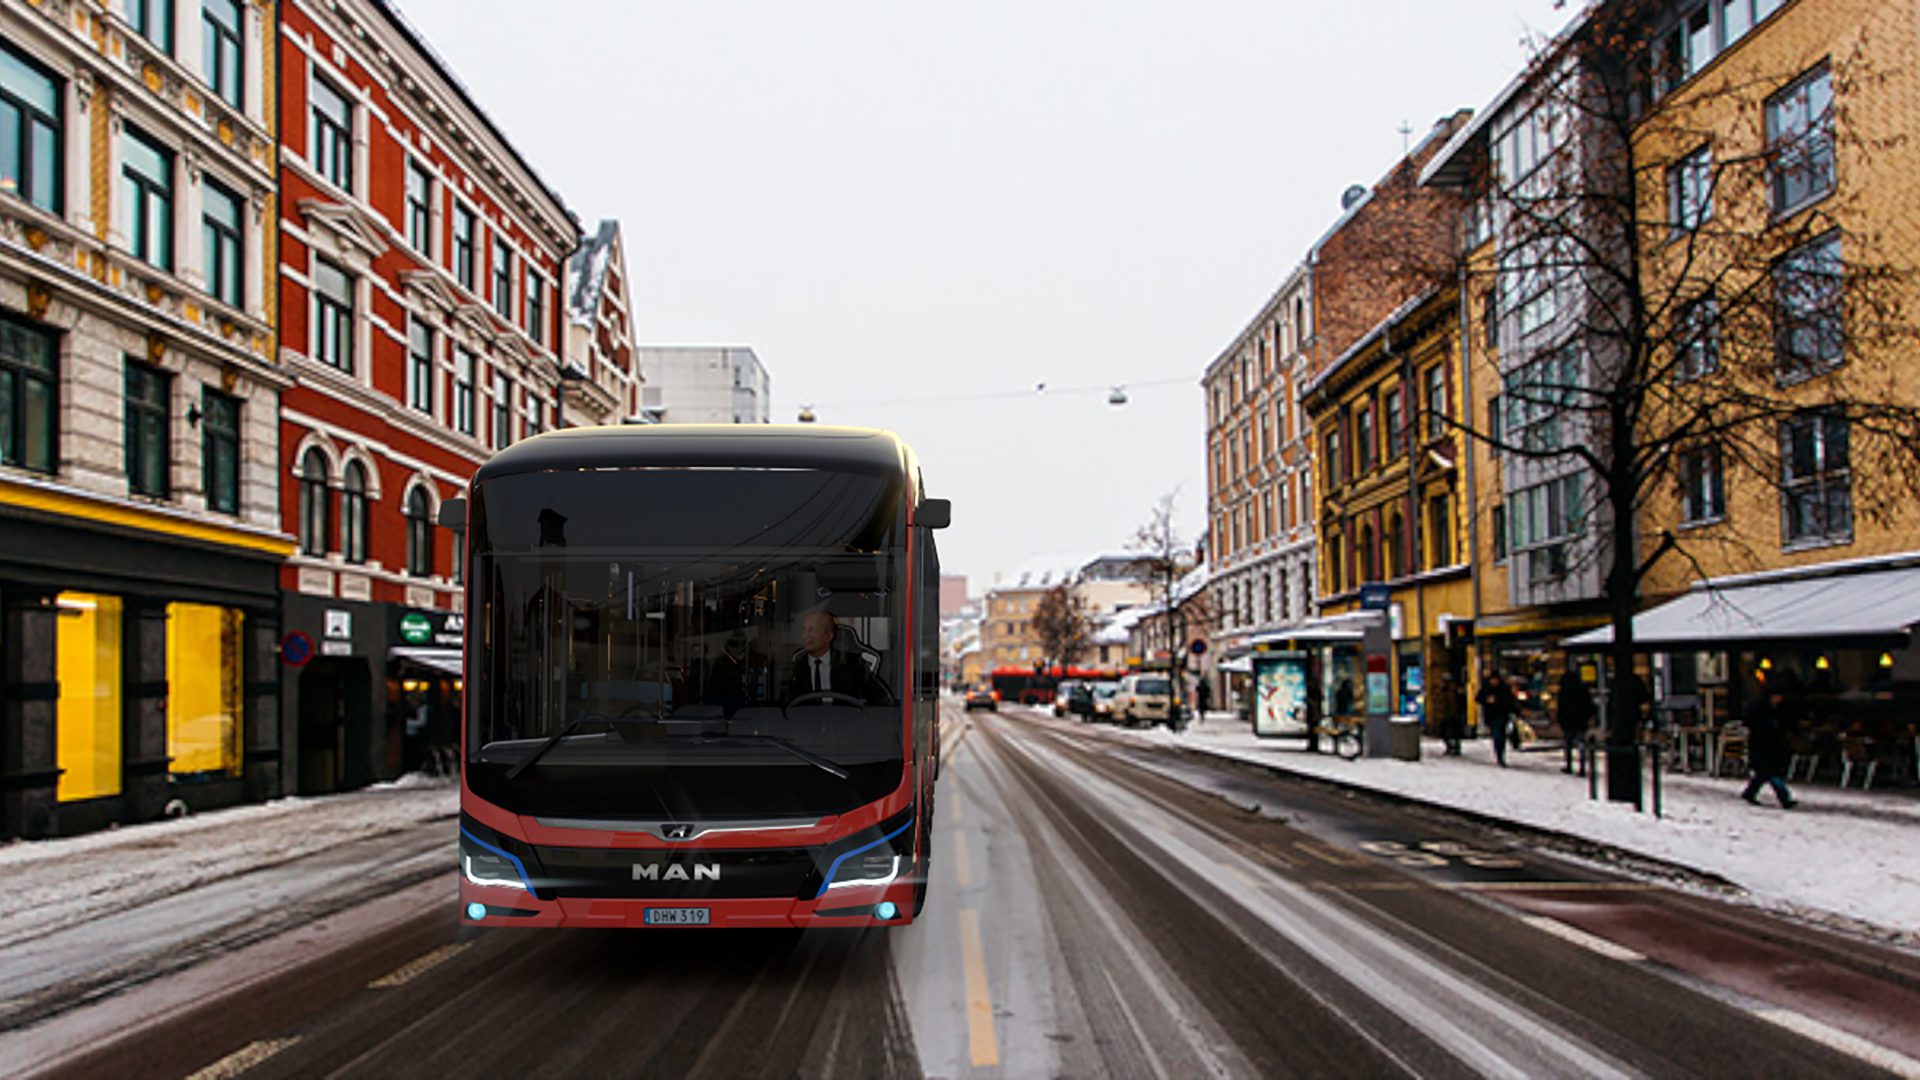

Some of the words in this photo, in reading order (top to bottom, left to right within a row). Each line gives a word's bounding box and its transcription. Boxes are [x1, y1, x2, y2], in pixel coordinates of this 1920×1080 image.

[632, 863, 721, 881] MAN
[653, 909, 678, 922] DHW
[680, 909, 705, 922] 319
